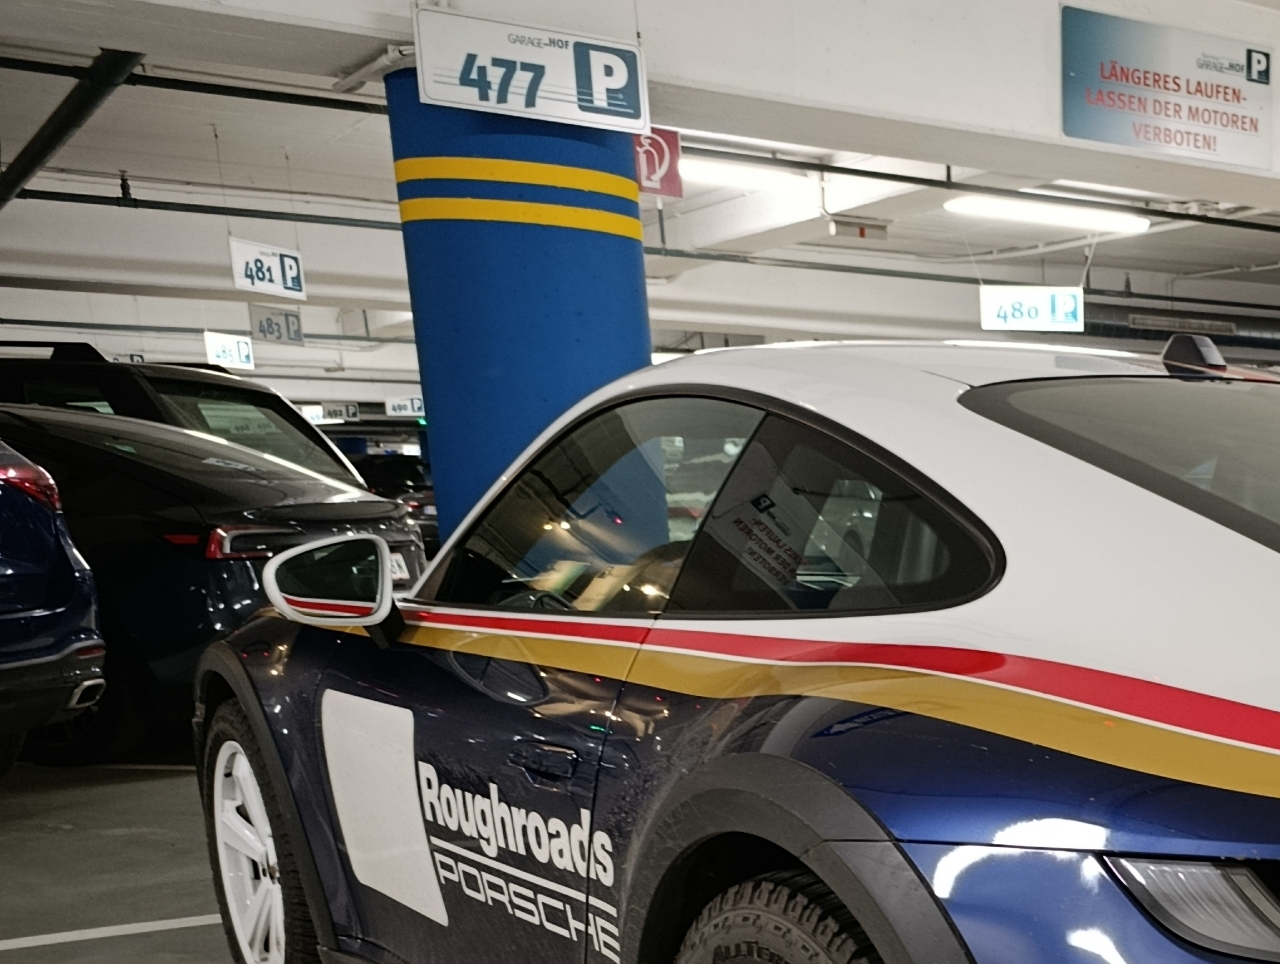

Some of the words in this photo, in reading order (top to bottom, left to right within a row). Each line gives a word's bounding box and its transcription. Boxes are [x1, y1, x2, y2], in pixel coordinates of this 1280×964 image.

[459, 53, 546, 109] 477
[590, 49, 628, 107] P
[1251, 51, 1267, 80] P
[1100, 60, 1181, 93] LÄNGERES
[1186, 79, 1247, 104] LAUFEN-
[1085, 87, 1148, 114] LASSEN
[1152, 99, 1182, 120] DER
[1187, 105, 1259, 133] MOTOREN
[1132, 121, 1218, 152] VERBOTEN!
[244, 258, 274, 286] 481
[283, 256, 298, 288] P
[258, 317, 282, 340] 483
[996, 301, 1039, 324] 480
[417, 760, 615, 888] Roughroads
